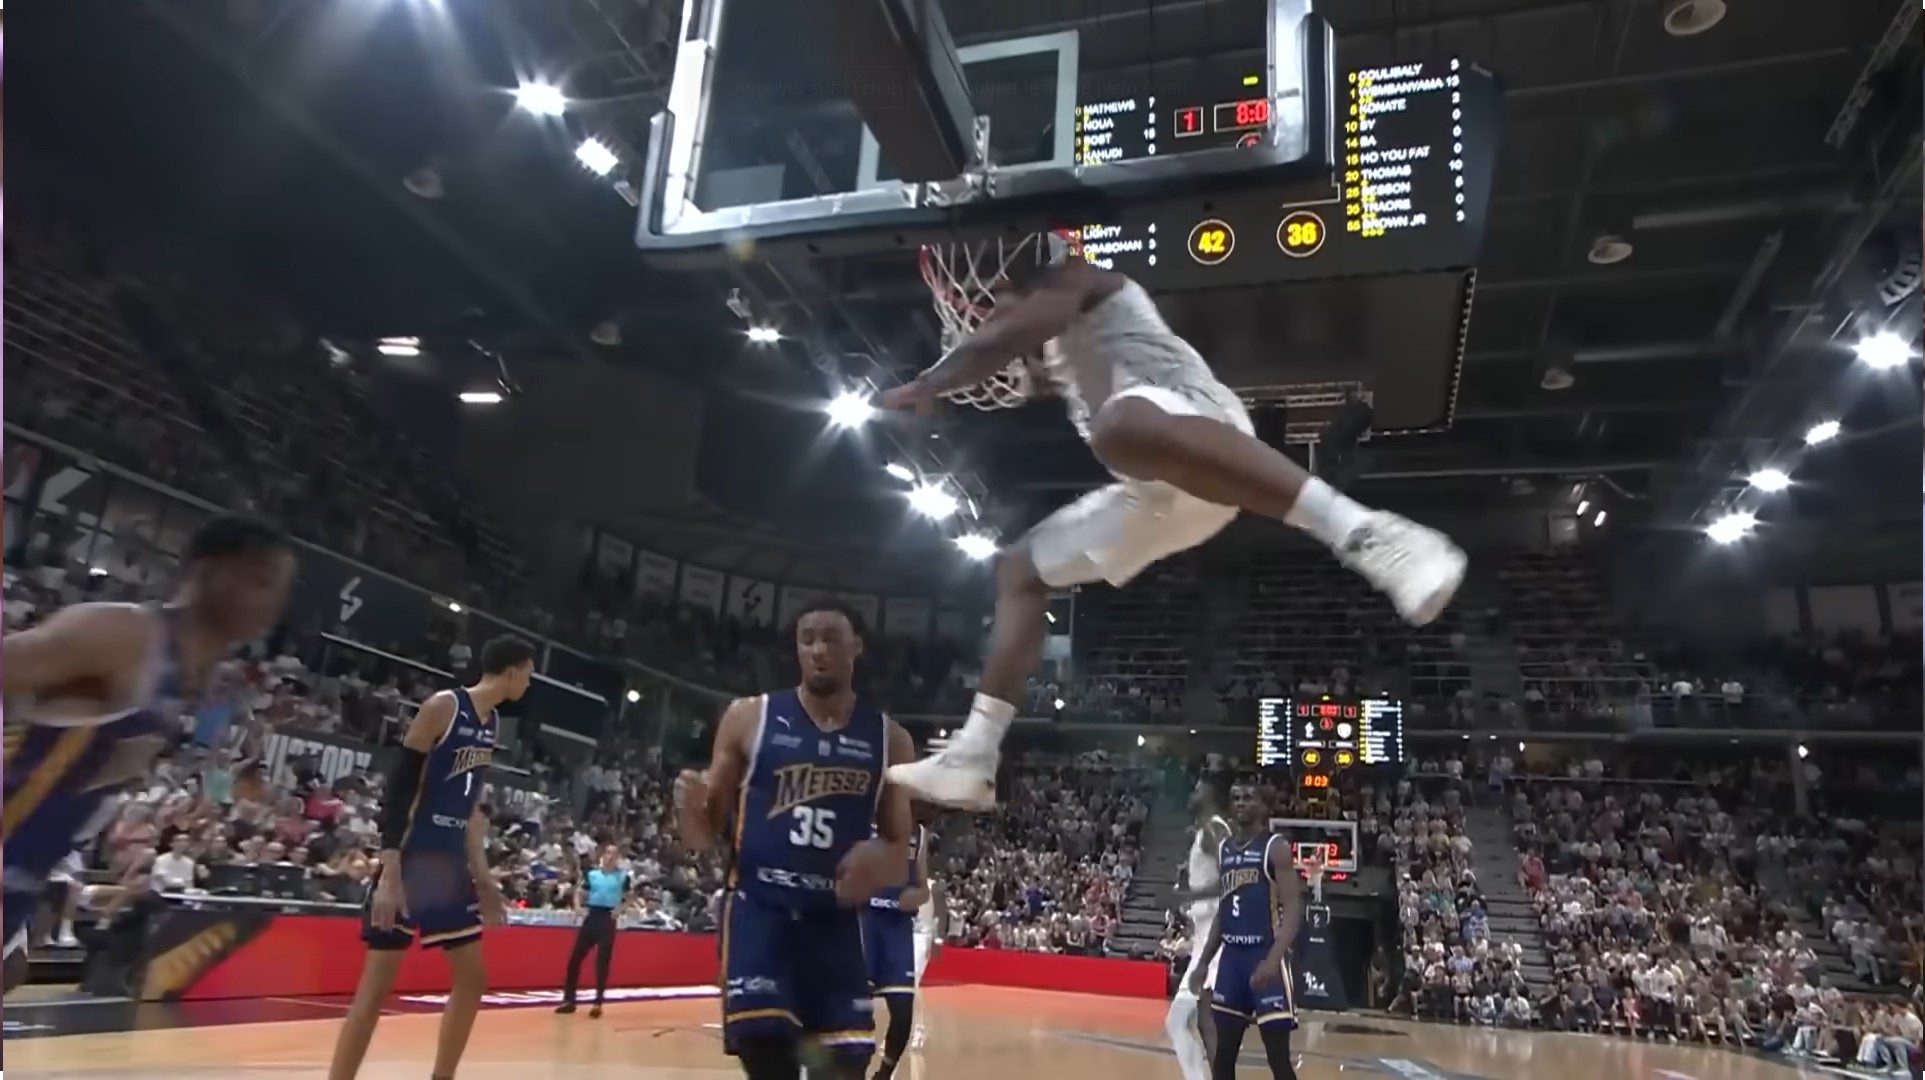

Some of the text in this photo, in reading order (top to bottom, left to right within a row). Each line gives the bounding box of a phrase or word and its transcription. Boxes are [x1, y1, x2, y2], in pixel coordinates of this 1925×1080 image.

[1236, 100, 1268, 124] 8:0
[1198, 222, 1317, 253] 42 36
[464, 771, 473, 796] 1
[789, 805, 836, 849] 35
[1232, 895, 1240, 917] 5
